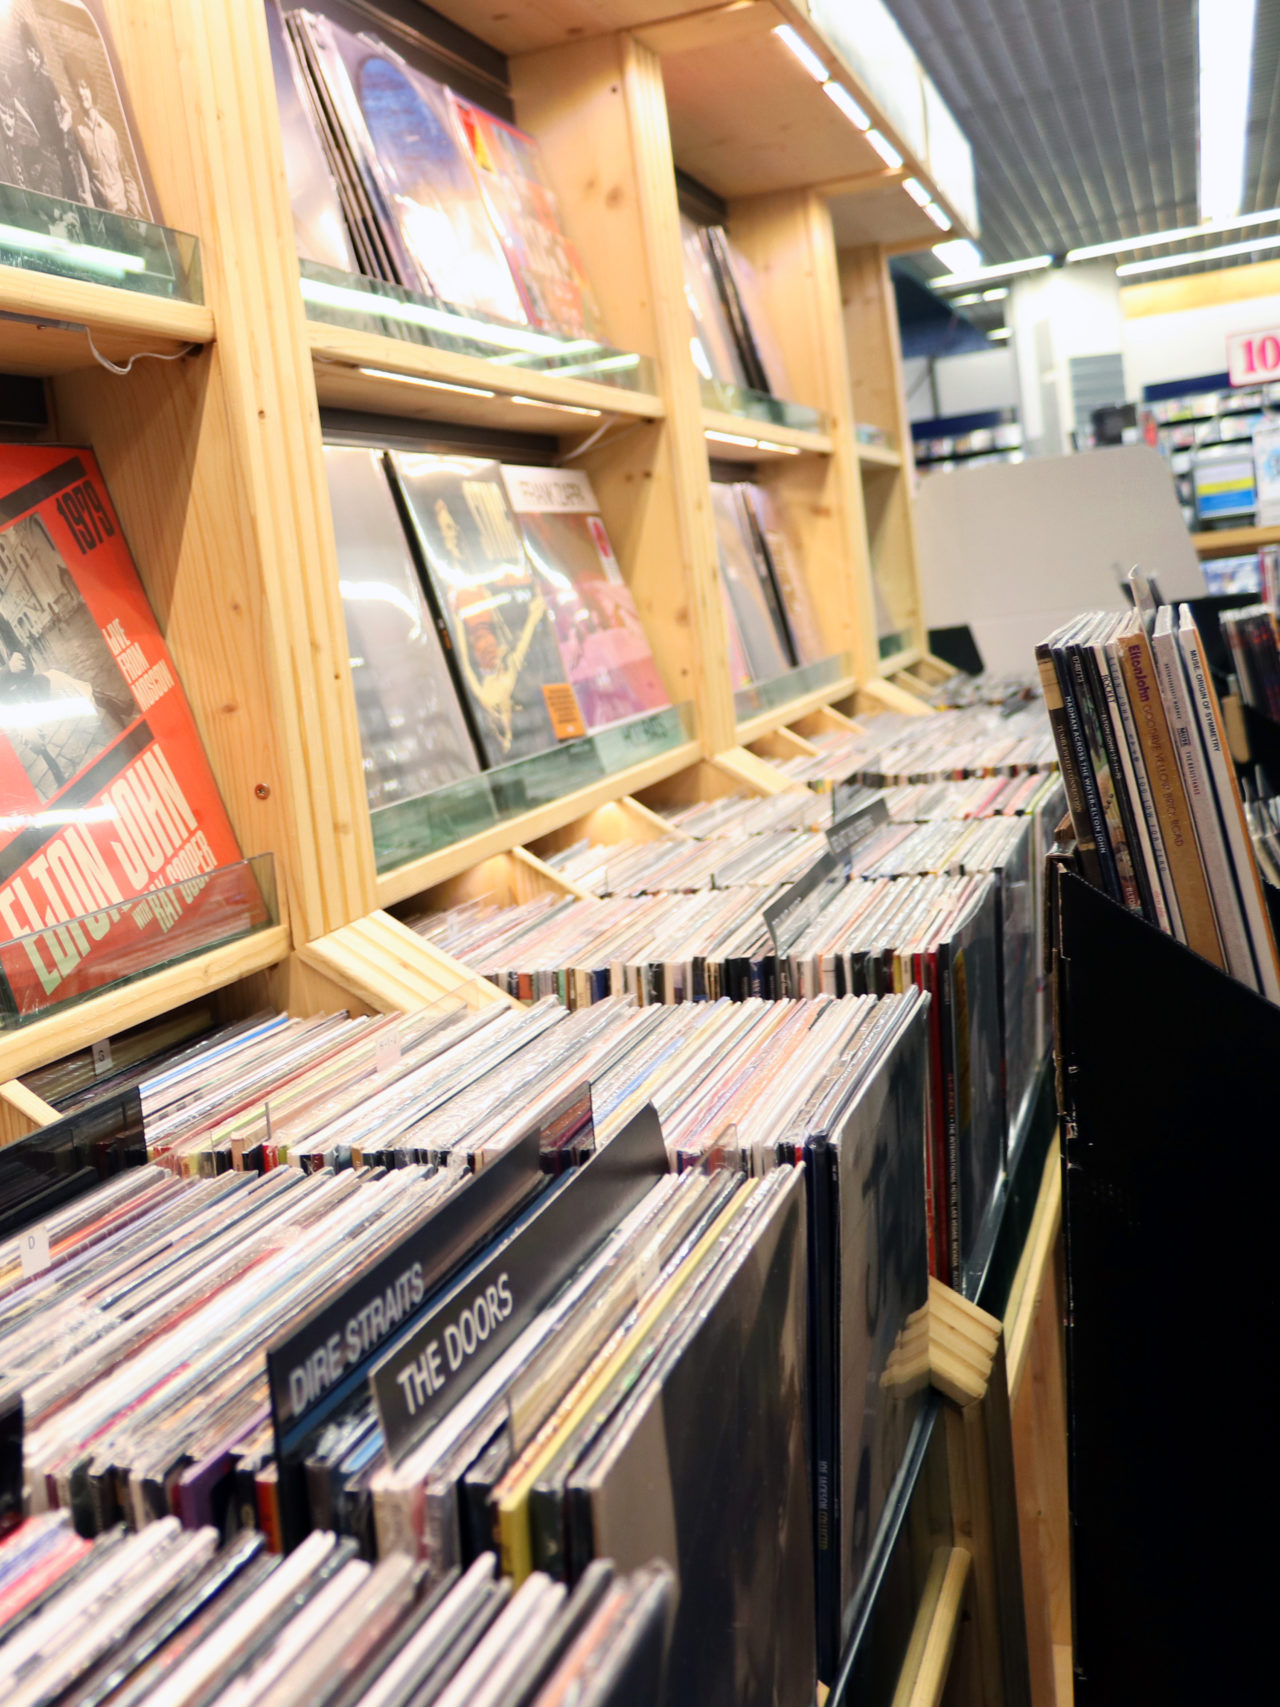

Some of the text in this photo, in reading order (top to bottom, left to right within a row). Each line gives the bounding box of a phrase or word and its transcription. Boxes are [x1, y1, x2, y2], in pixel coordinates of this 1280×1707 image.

[56, 479, 115, 555] 1979
[116, 642, 150, 685] FROM
[1195, 674, 1208, 700] ORIGIN
[1202, 701, 1211, 711] OF
[1065, 695, 1077, 730] MADMAN
[1072, 730, 1085, 760] ACROSS
[1080, 760, 1089, 777] THE
[1095, 831, 1107, 854] JOHN
[1205, 712, 1221, 752] SYMMETRY
[101, 744, 198, 891] JOHN
[144, 876, 183, 933] RAY
[165, 830, 218, 904] COOPER
[288, 1261, 425, 1417] DIRE STRAITS
[396, 1272, 513, 1416] THE DOORS
